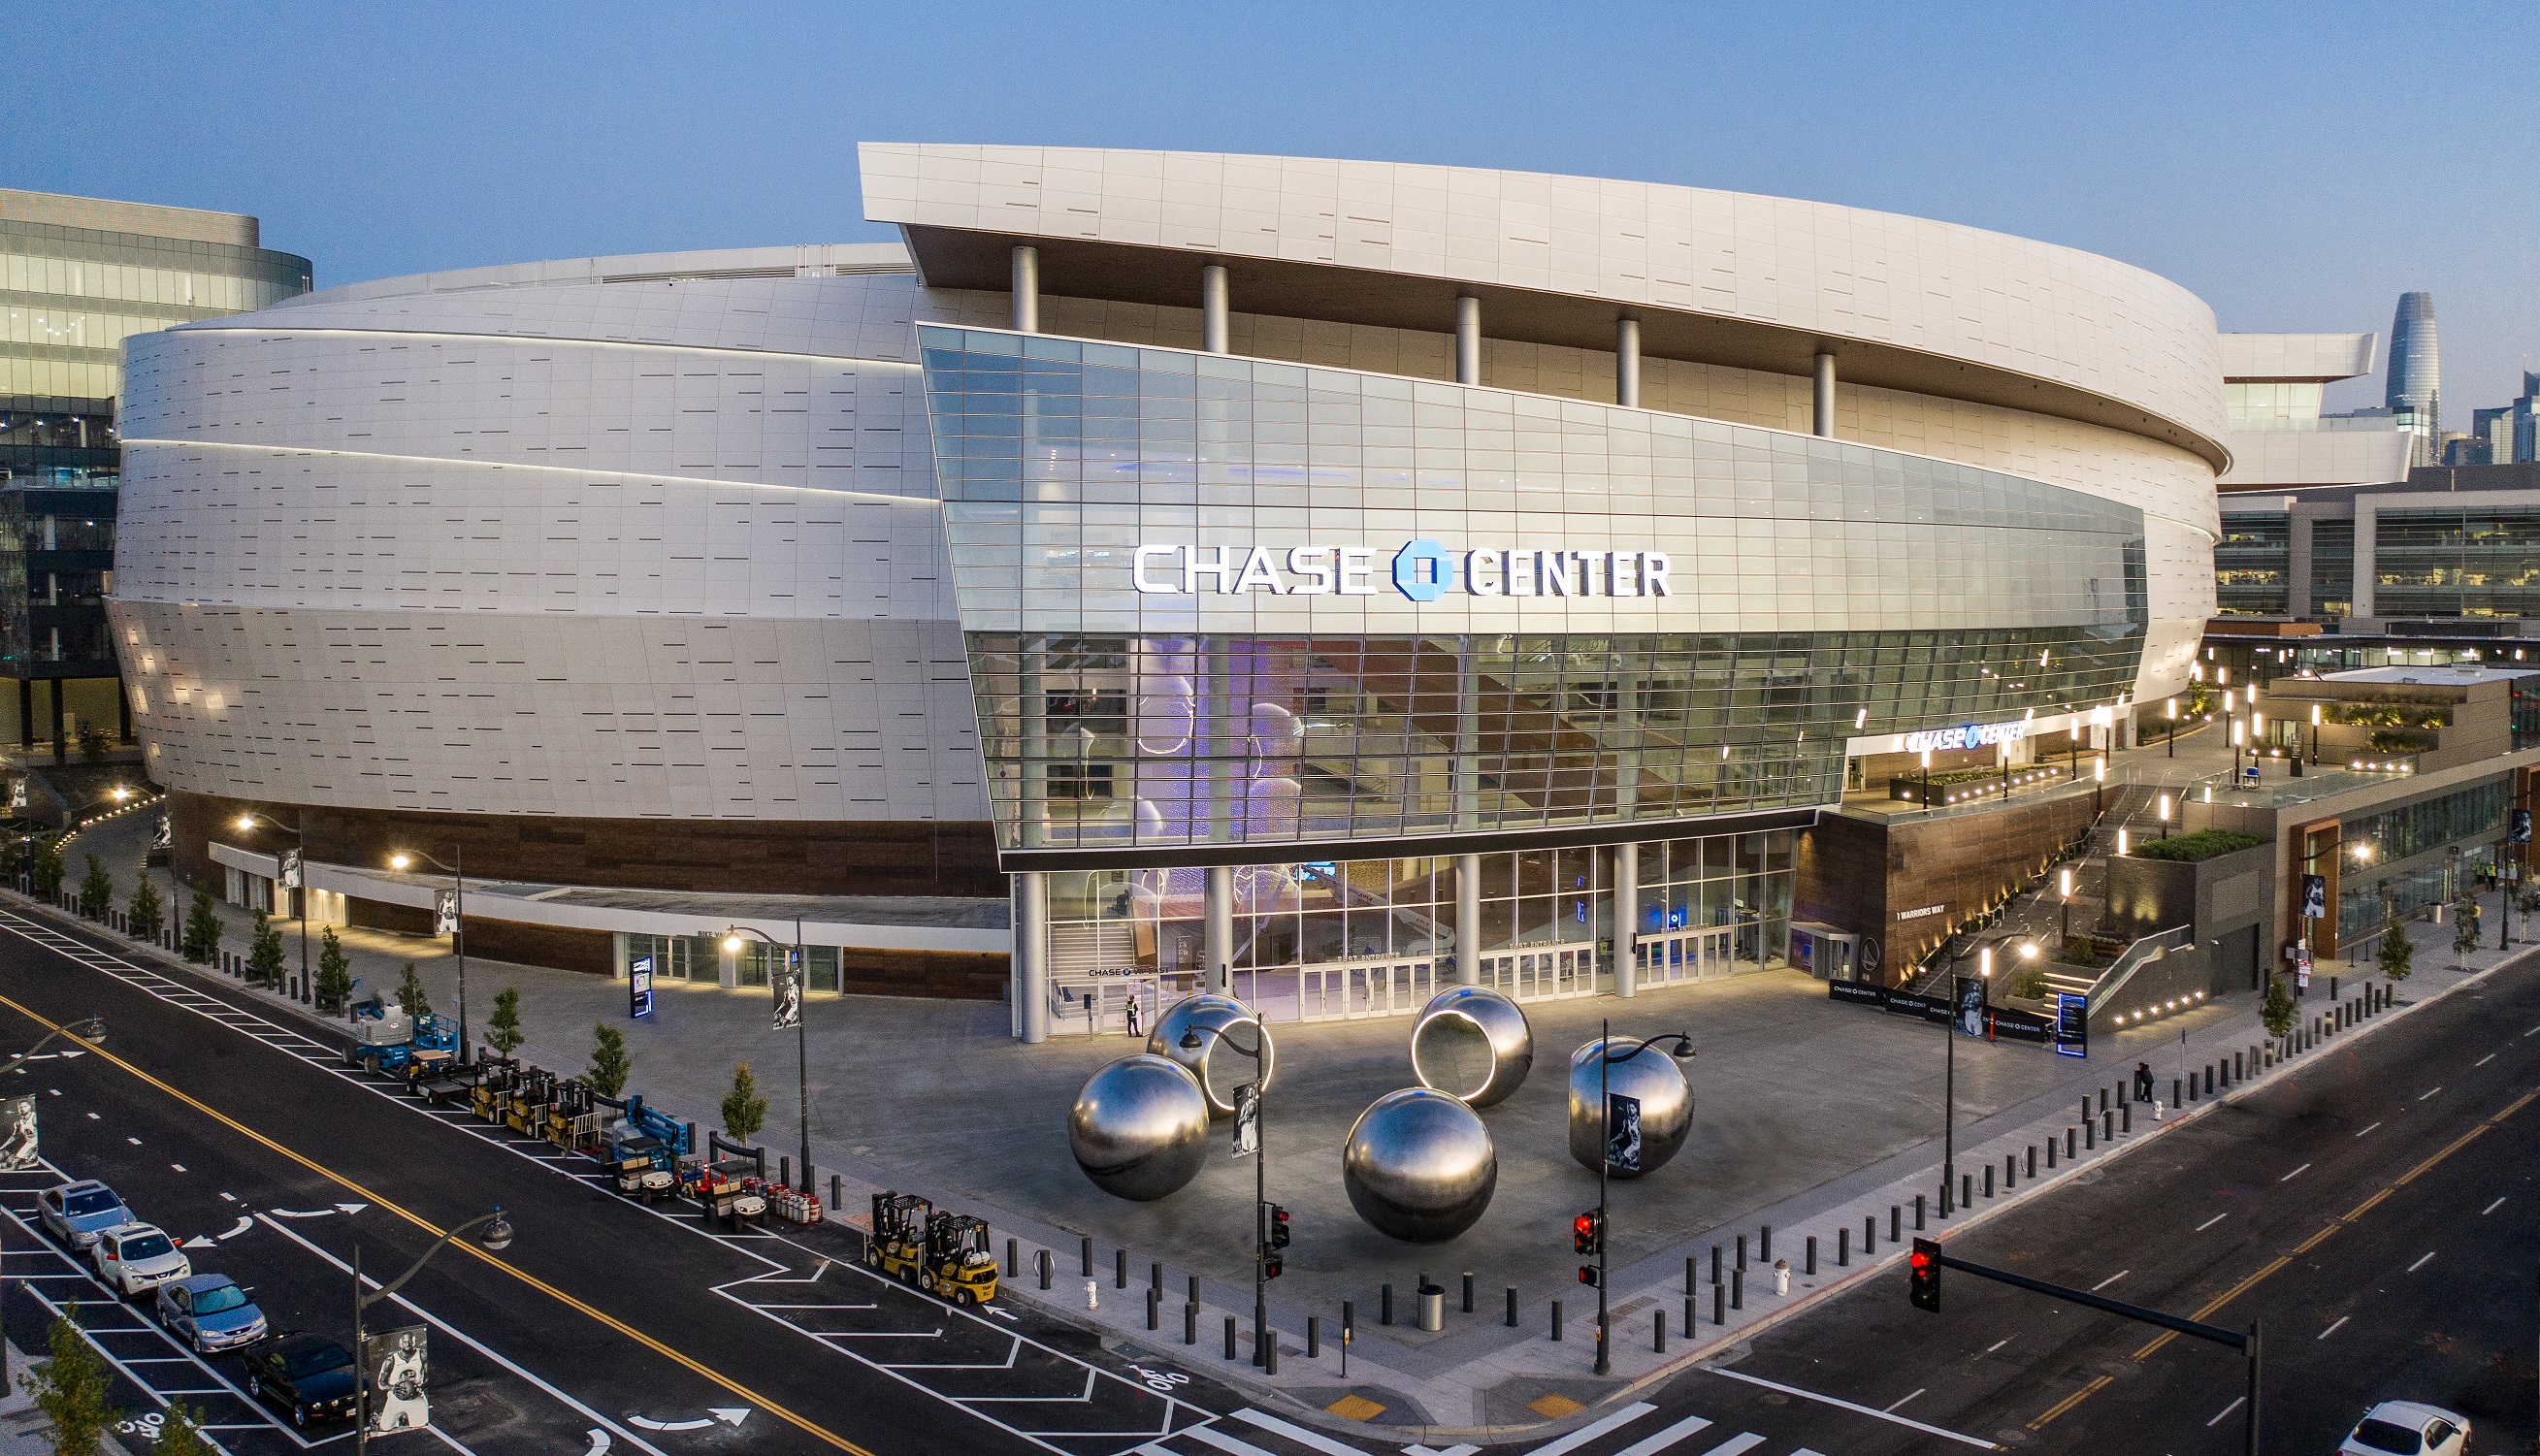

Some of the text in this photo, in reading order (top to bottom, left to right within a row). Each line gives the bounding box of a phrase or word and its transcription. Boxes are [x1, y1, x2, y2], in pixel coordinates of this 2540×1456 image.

[1131, 544, 1674, 598] CHASE CENTER
[1905, 723, 2025, 753] CHASE CENTER
[1901, 908, 1931, 920] WARRIORS
[1932, 905, 1944, 914] WAY
[1530, 939, 1564, 948] ENTRANCE
[1360, 952, 1400, 961] ENTRANCE
[1089, 968, 1122, 977] CHASE
[1890, 997, 1908, 1006] CHASE
[1930, 1007, 1948, 1016] CHASE
[1996, 1019, 2040, 1033] CHASE CENTER
